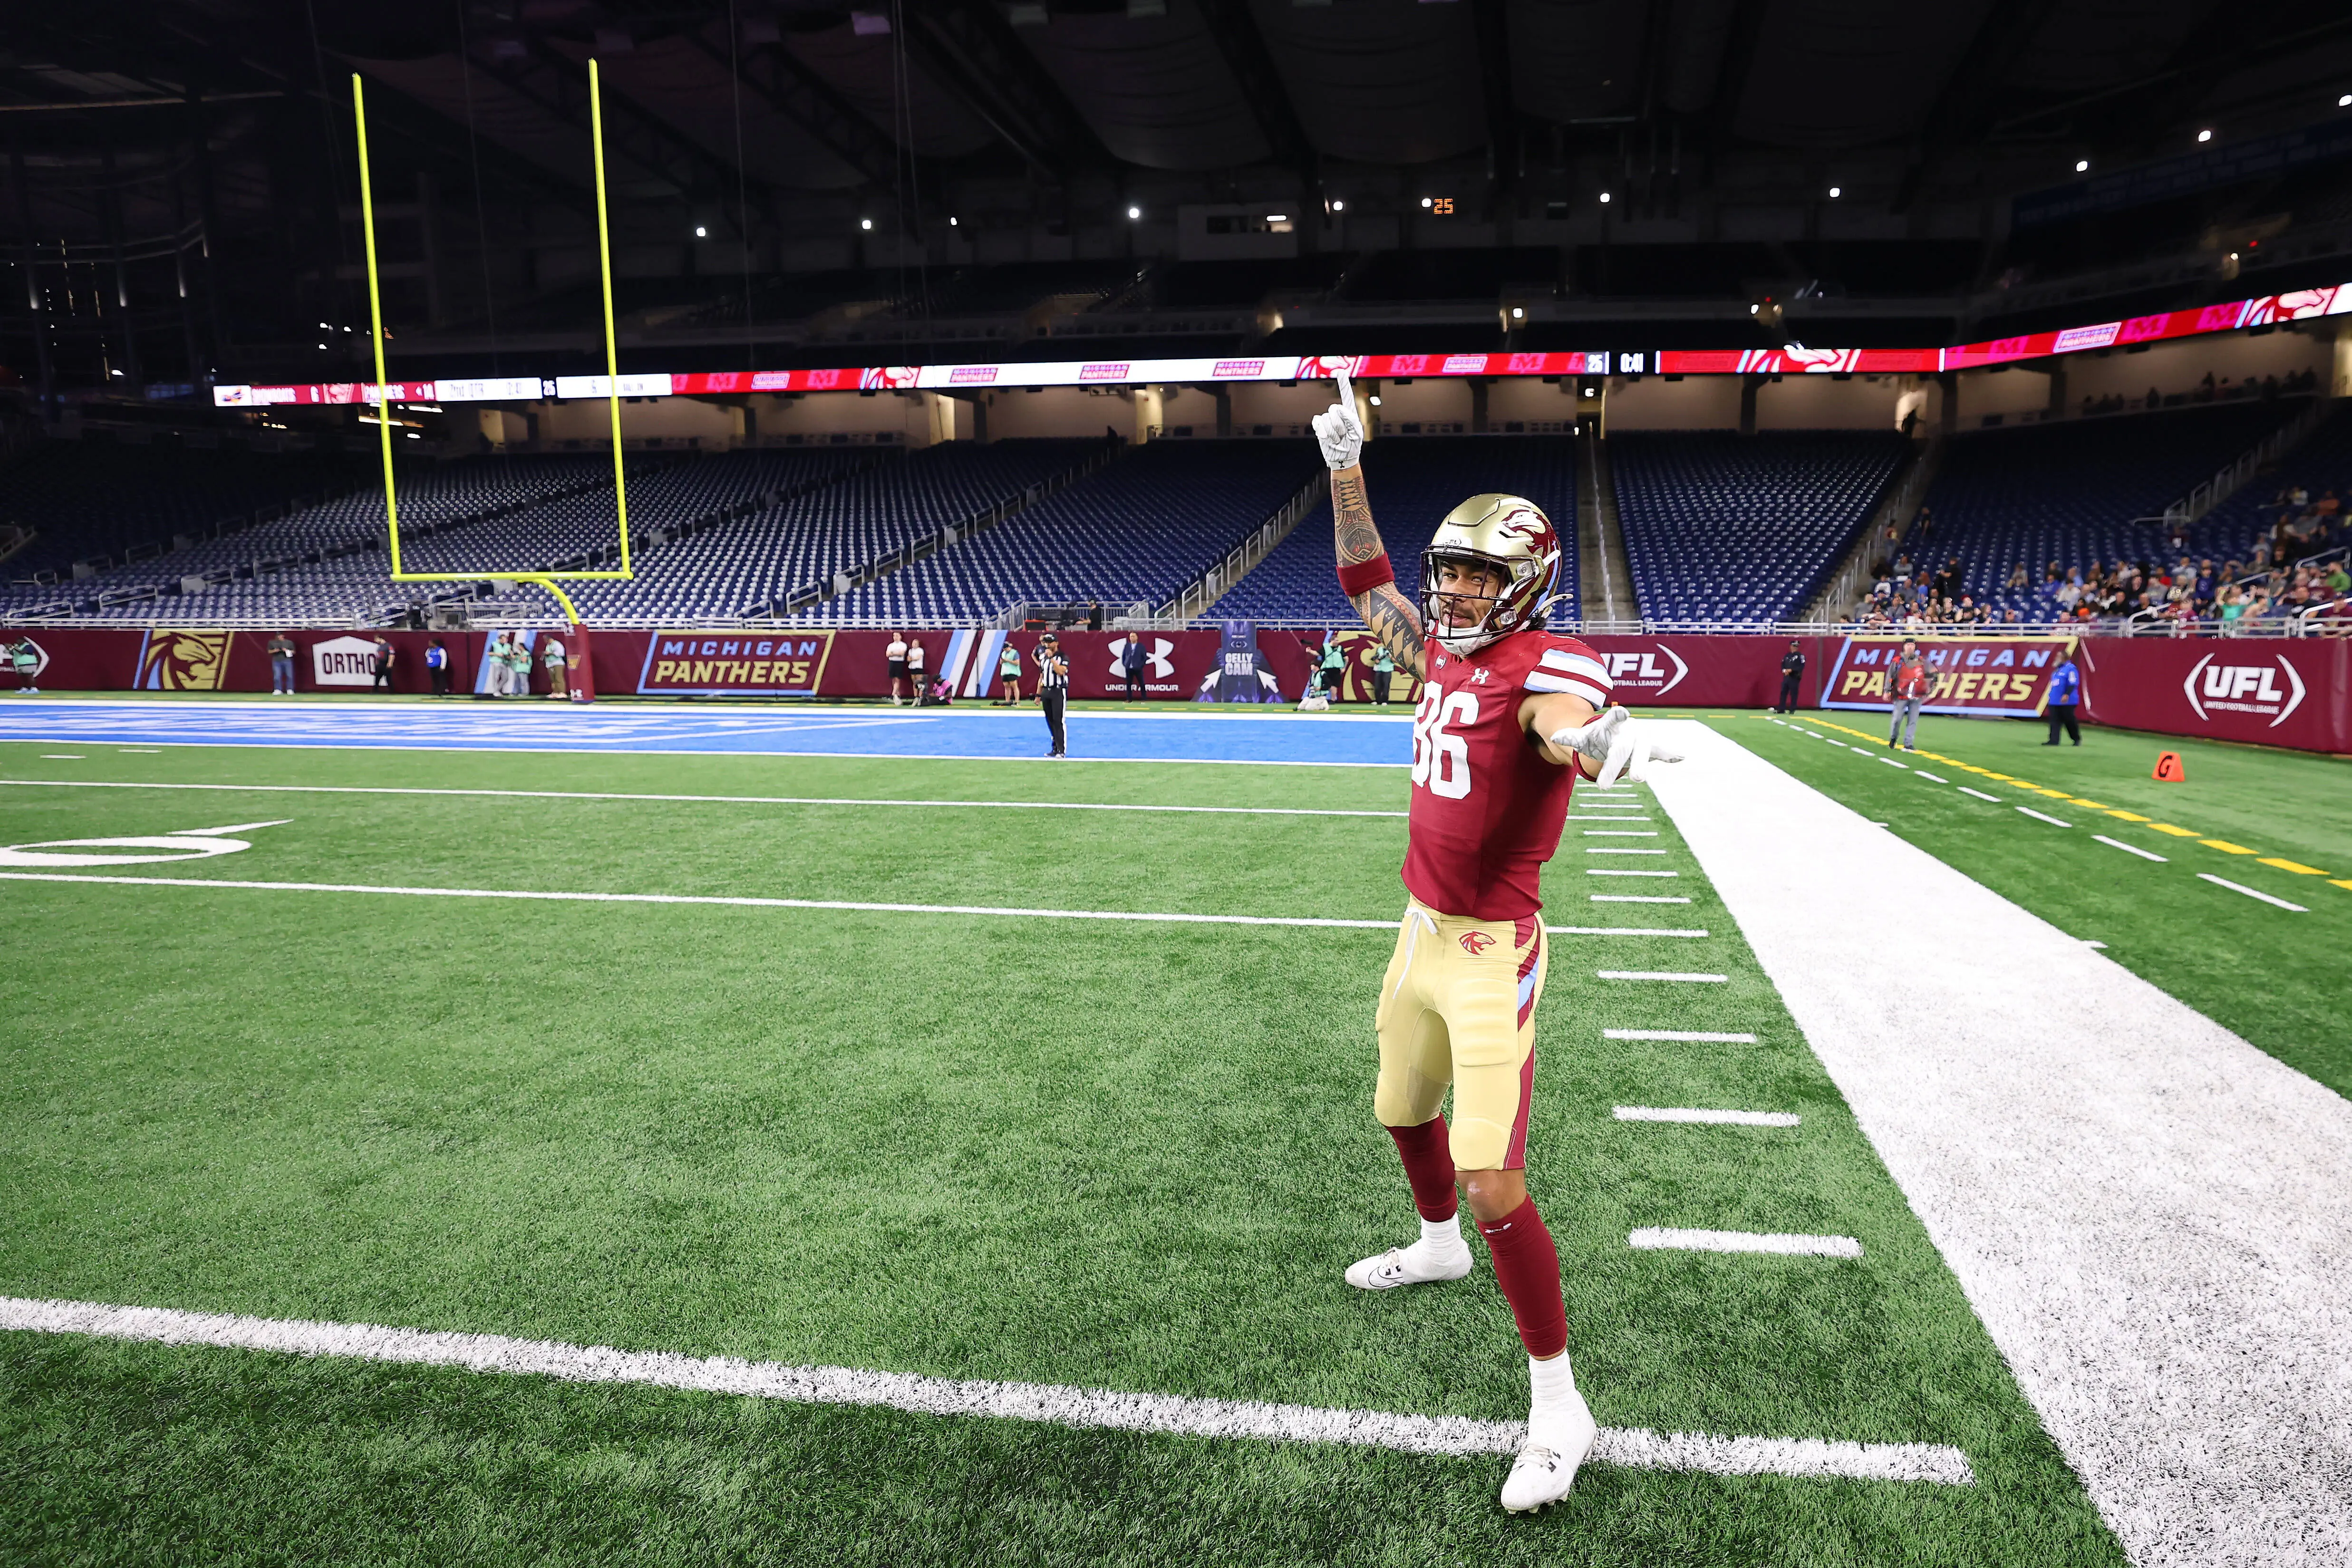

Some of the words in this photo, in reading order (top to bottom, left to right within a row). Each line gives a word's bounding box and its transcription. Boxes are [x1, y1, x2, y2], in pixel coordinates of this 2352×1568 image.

[1434, 198, 1453, 214] 25
[1214, 367, 1260, 376] PANTHERS
[1587, 354, 1603, 372] 25
[1620, 353, 1644, 373] 0:41
[1081, 371, 1126, 379] PANTHERS
[662, 641, 817, 656] MICHIGAN
[323, 653, 377, 675] ORTHO
[1225, 653, 1253, 663] CELLY
[1855, 649, 2050, 667] MIHIGAN
[654, 661, 811, 684] PANTHERS
[1225, 663, 1253, 675] CAM
[1841, 671, 2038, 701] PAHERS
[2203, 666, 2283, 702] UFL
[1412, 680, 1480, 800] 86
[2158, 755, 2173, 777] G
